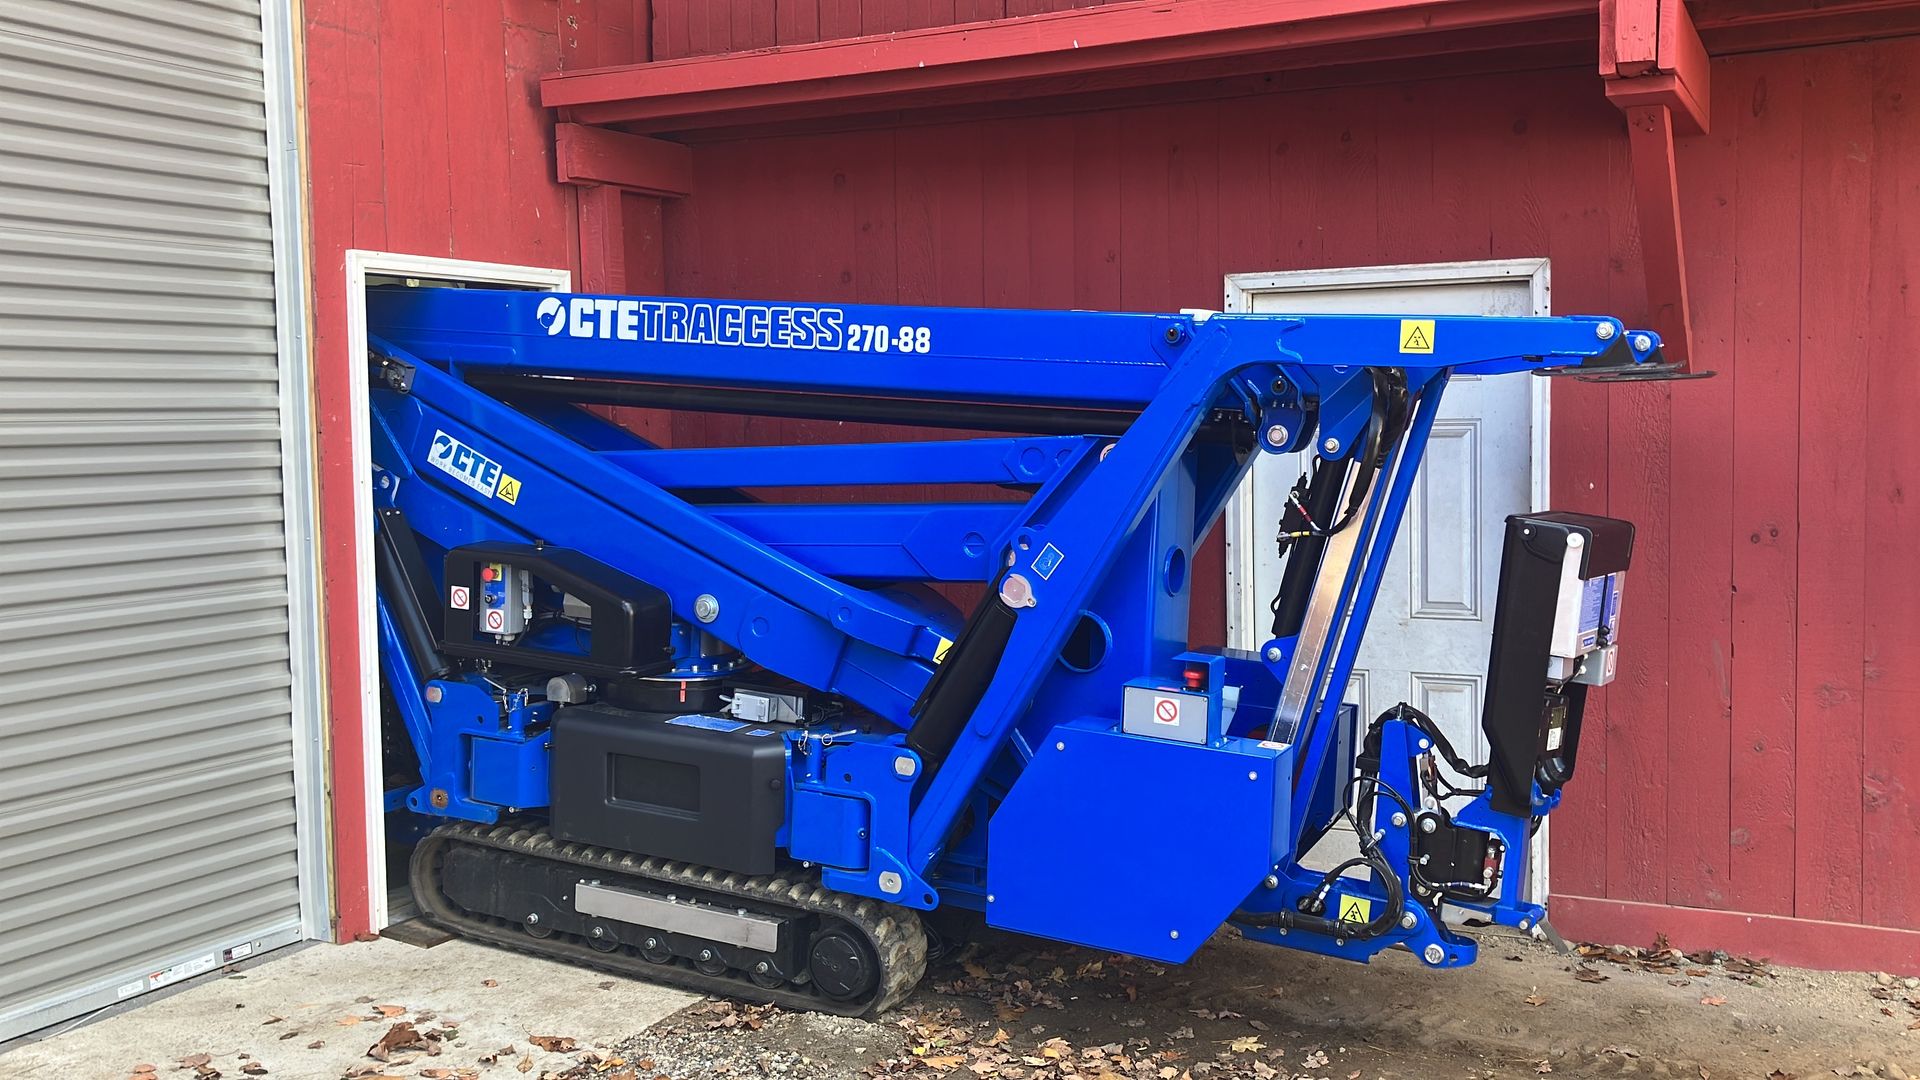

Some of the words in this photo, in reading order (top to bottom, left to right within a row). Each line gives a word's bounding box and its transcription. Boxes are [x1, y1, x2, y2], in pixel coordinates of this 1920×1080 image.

[847, 324, 931, 353] 270-88
[430, 456, 447, 469] WORK
[448, 466, 475, 487] BECOMES
[452, 444, 498, 488] CTE
